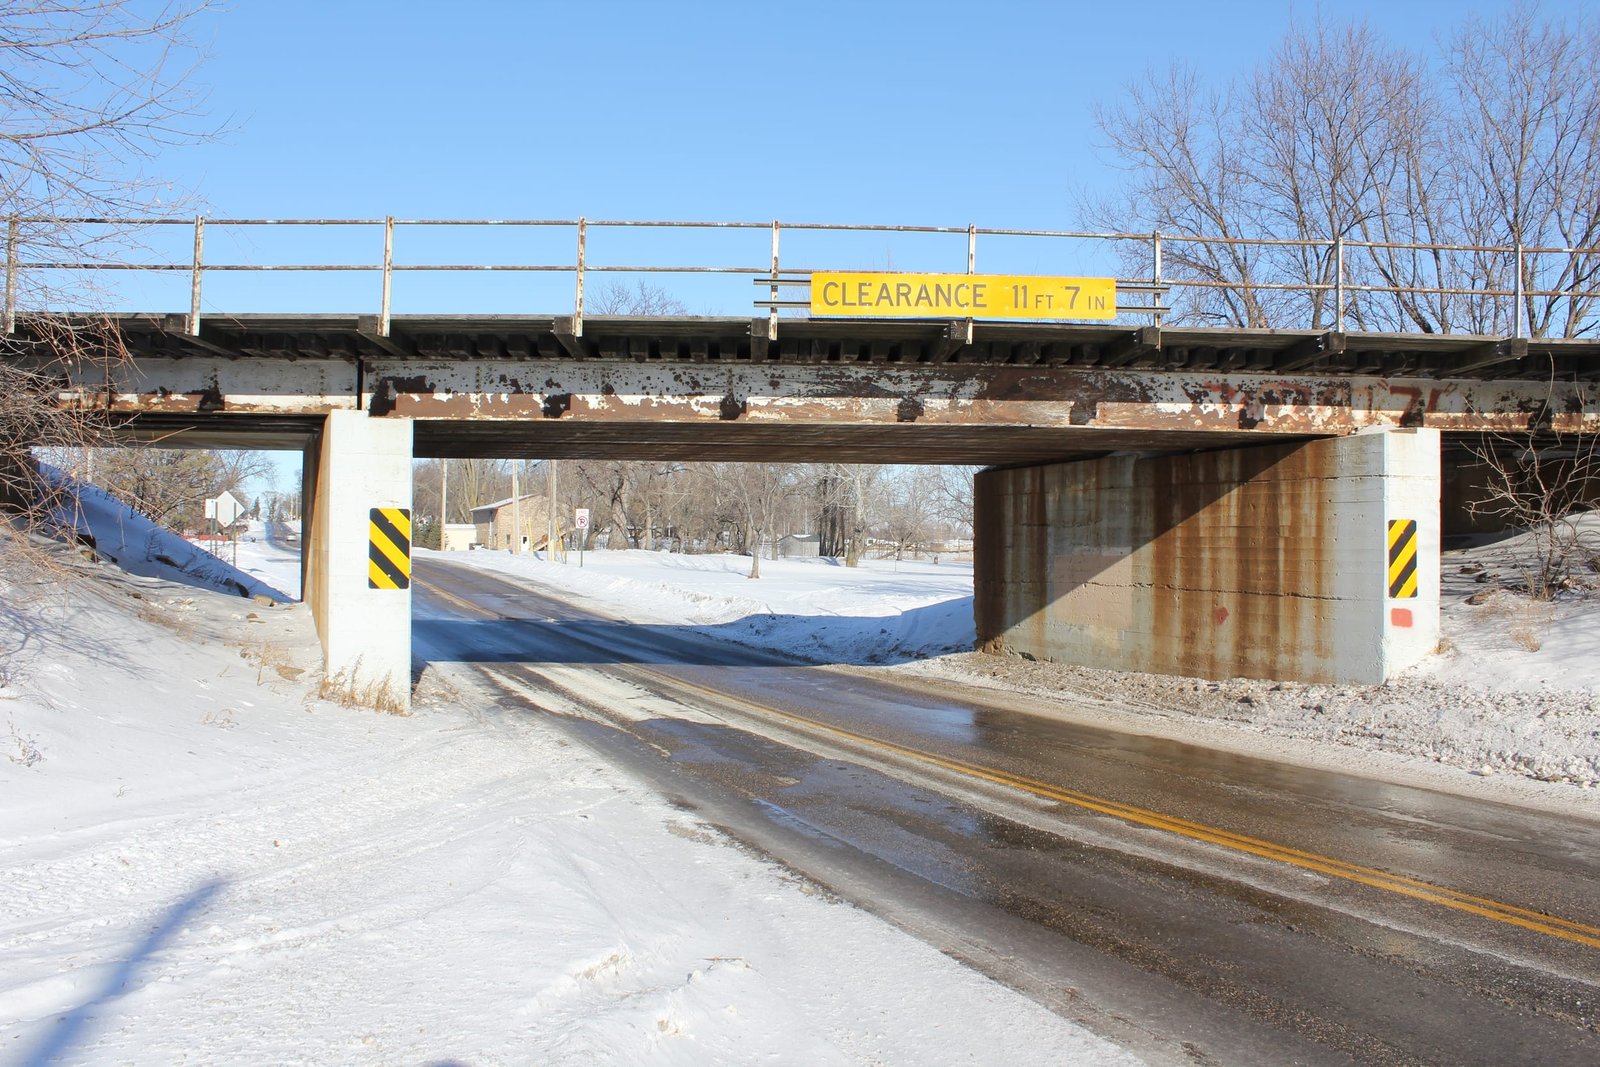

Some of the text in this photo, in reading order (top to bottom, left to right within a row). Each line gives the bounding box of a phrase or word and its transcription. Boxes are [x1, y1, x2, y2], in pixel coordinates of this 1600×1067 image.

[822, 281, 1105, 310] CLEARANCE 11 FT 7 IN
